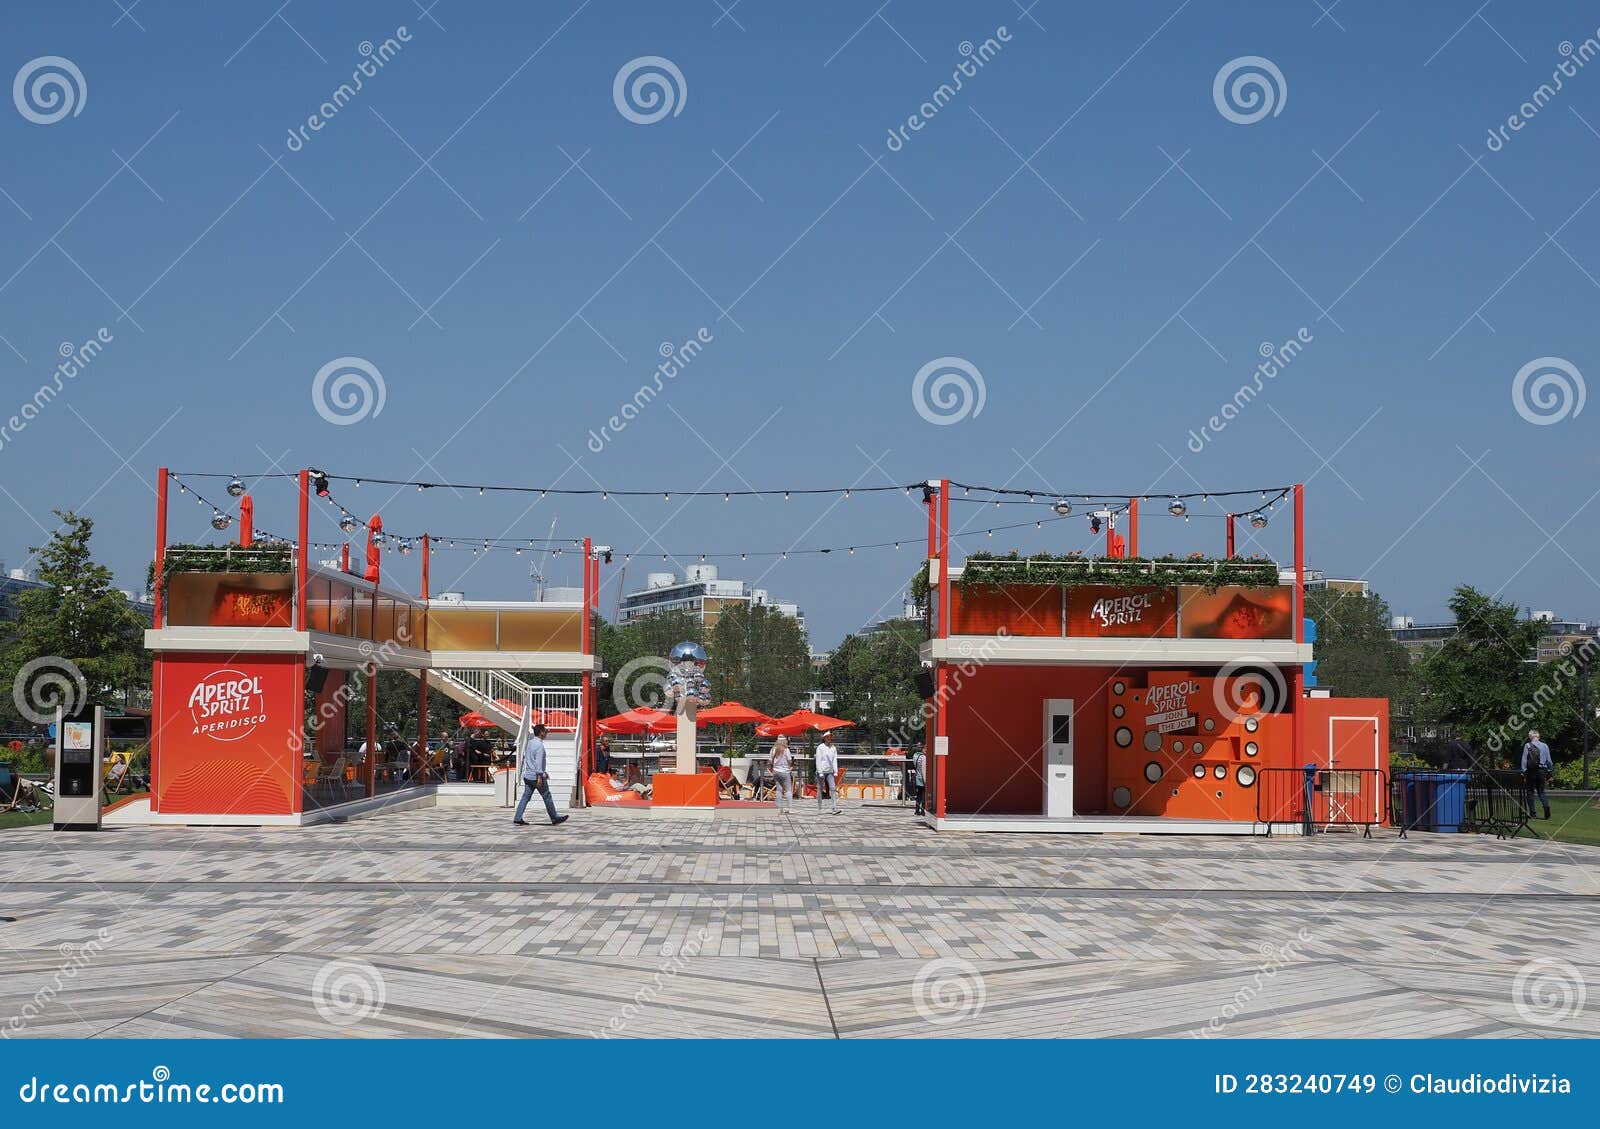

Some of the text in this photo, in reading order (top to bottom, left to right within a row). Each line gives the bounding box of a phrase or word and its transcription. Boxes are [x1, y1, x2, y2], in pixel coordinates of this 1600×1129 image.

[1090, 593, 1152, 619] APEROL
[188, 676, 262, 708] APEROL
[1145, 680, 1196, 706] APEROL
[192, 714, 267, 735] APERIDISCO
[1161, 718, 1193, 732] THE JOY
[1164, 710, 1184, 721] JOIN
